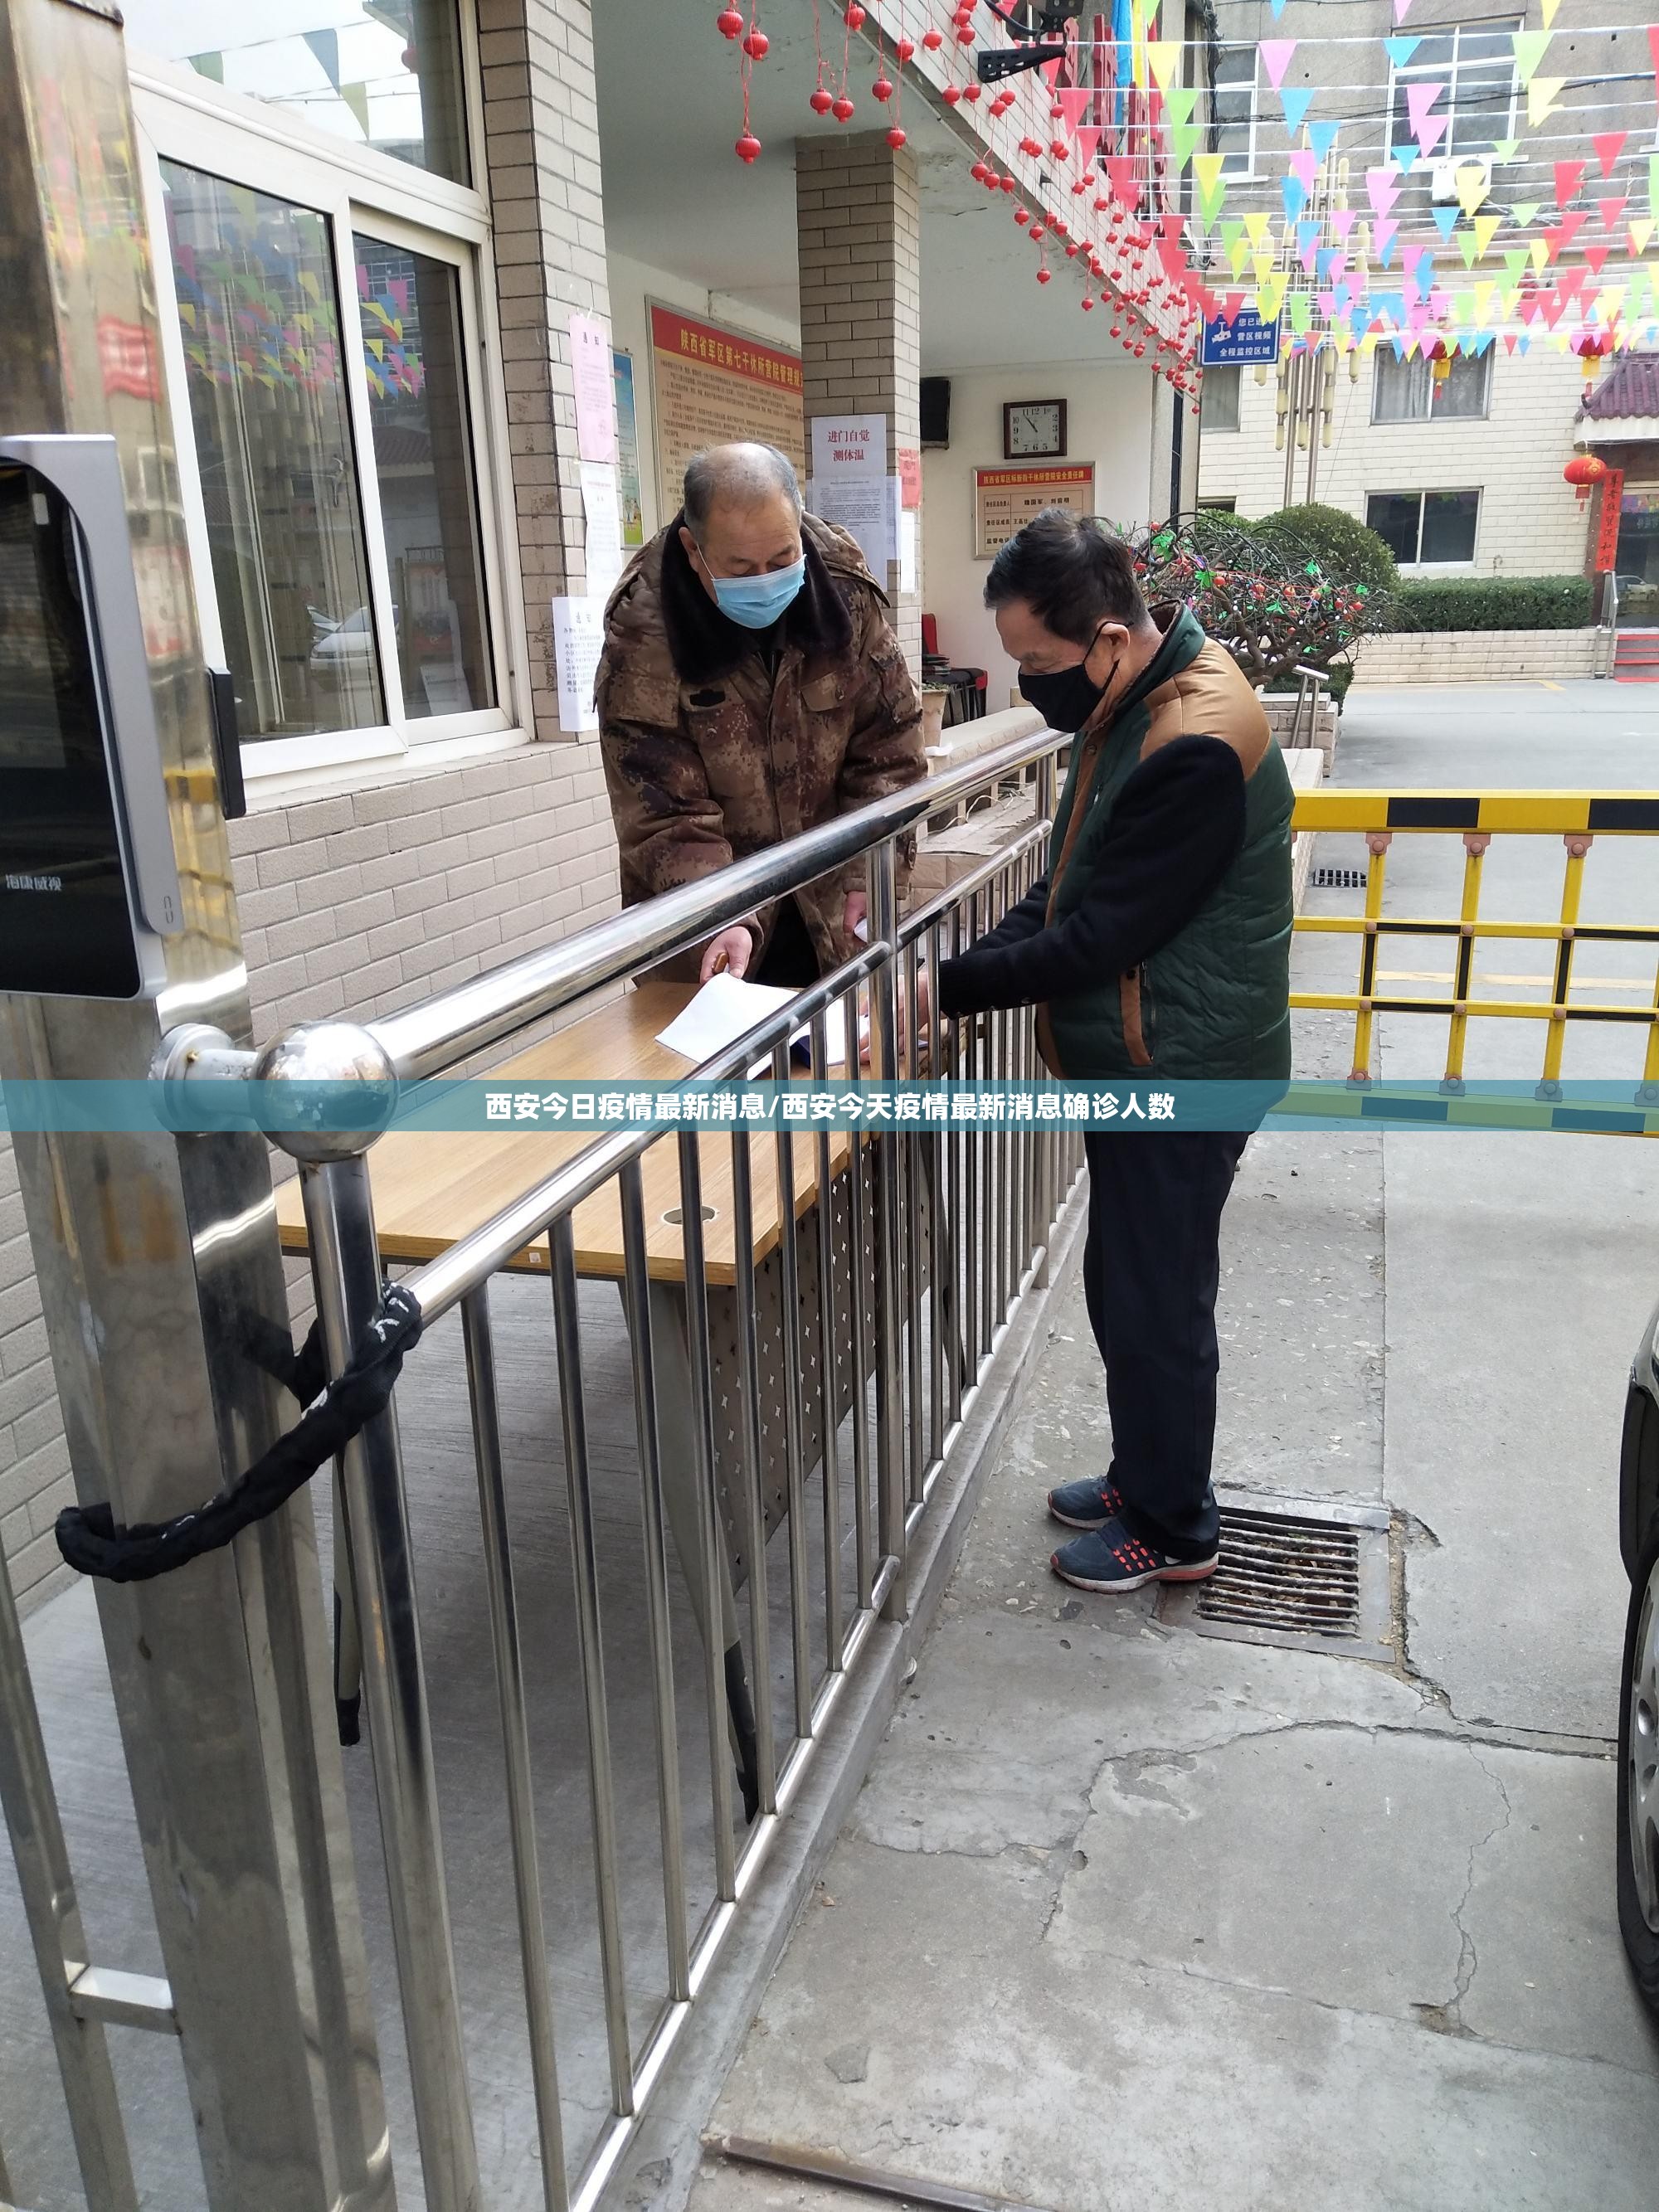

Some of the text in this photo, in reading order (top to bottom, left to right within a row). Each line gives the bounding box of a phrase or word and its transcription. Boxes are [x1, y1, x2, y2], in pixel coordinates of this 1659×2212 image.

[1238, 317, 1272, 327] 您已进
[1237, 331, 1272, 341] 营区视频
[680, 328, 803, 387] 陕西省军区第七干休所营院管理规
[1219, 346, 1270, 357] 全程监控区域
[828, 429, 870, 443] 进门自觉
[833, 449, 864, 462] 测体温
[5, 873, 62, 892] 海康威视
